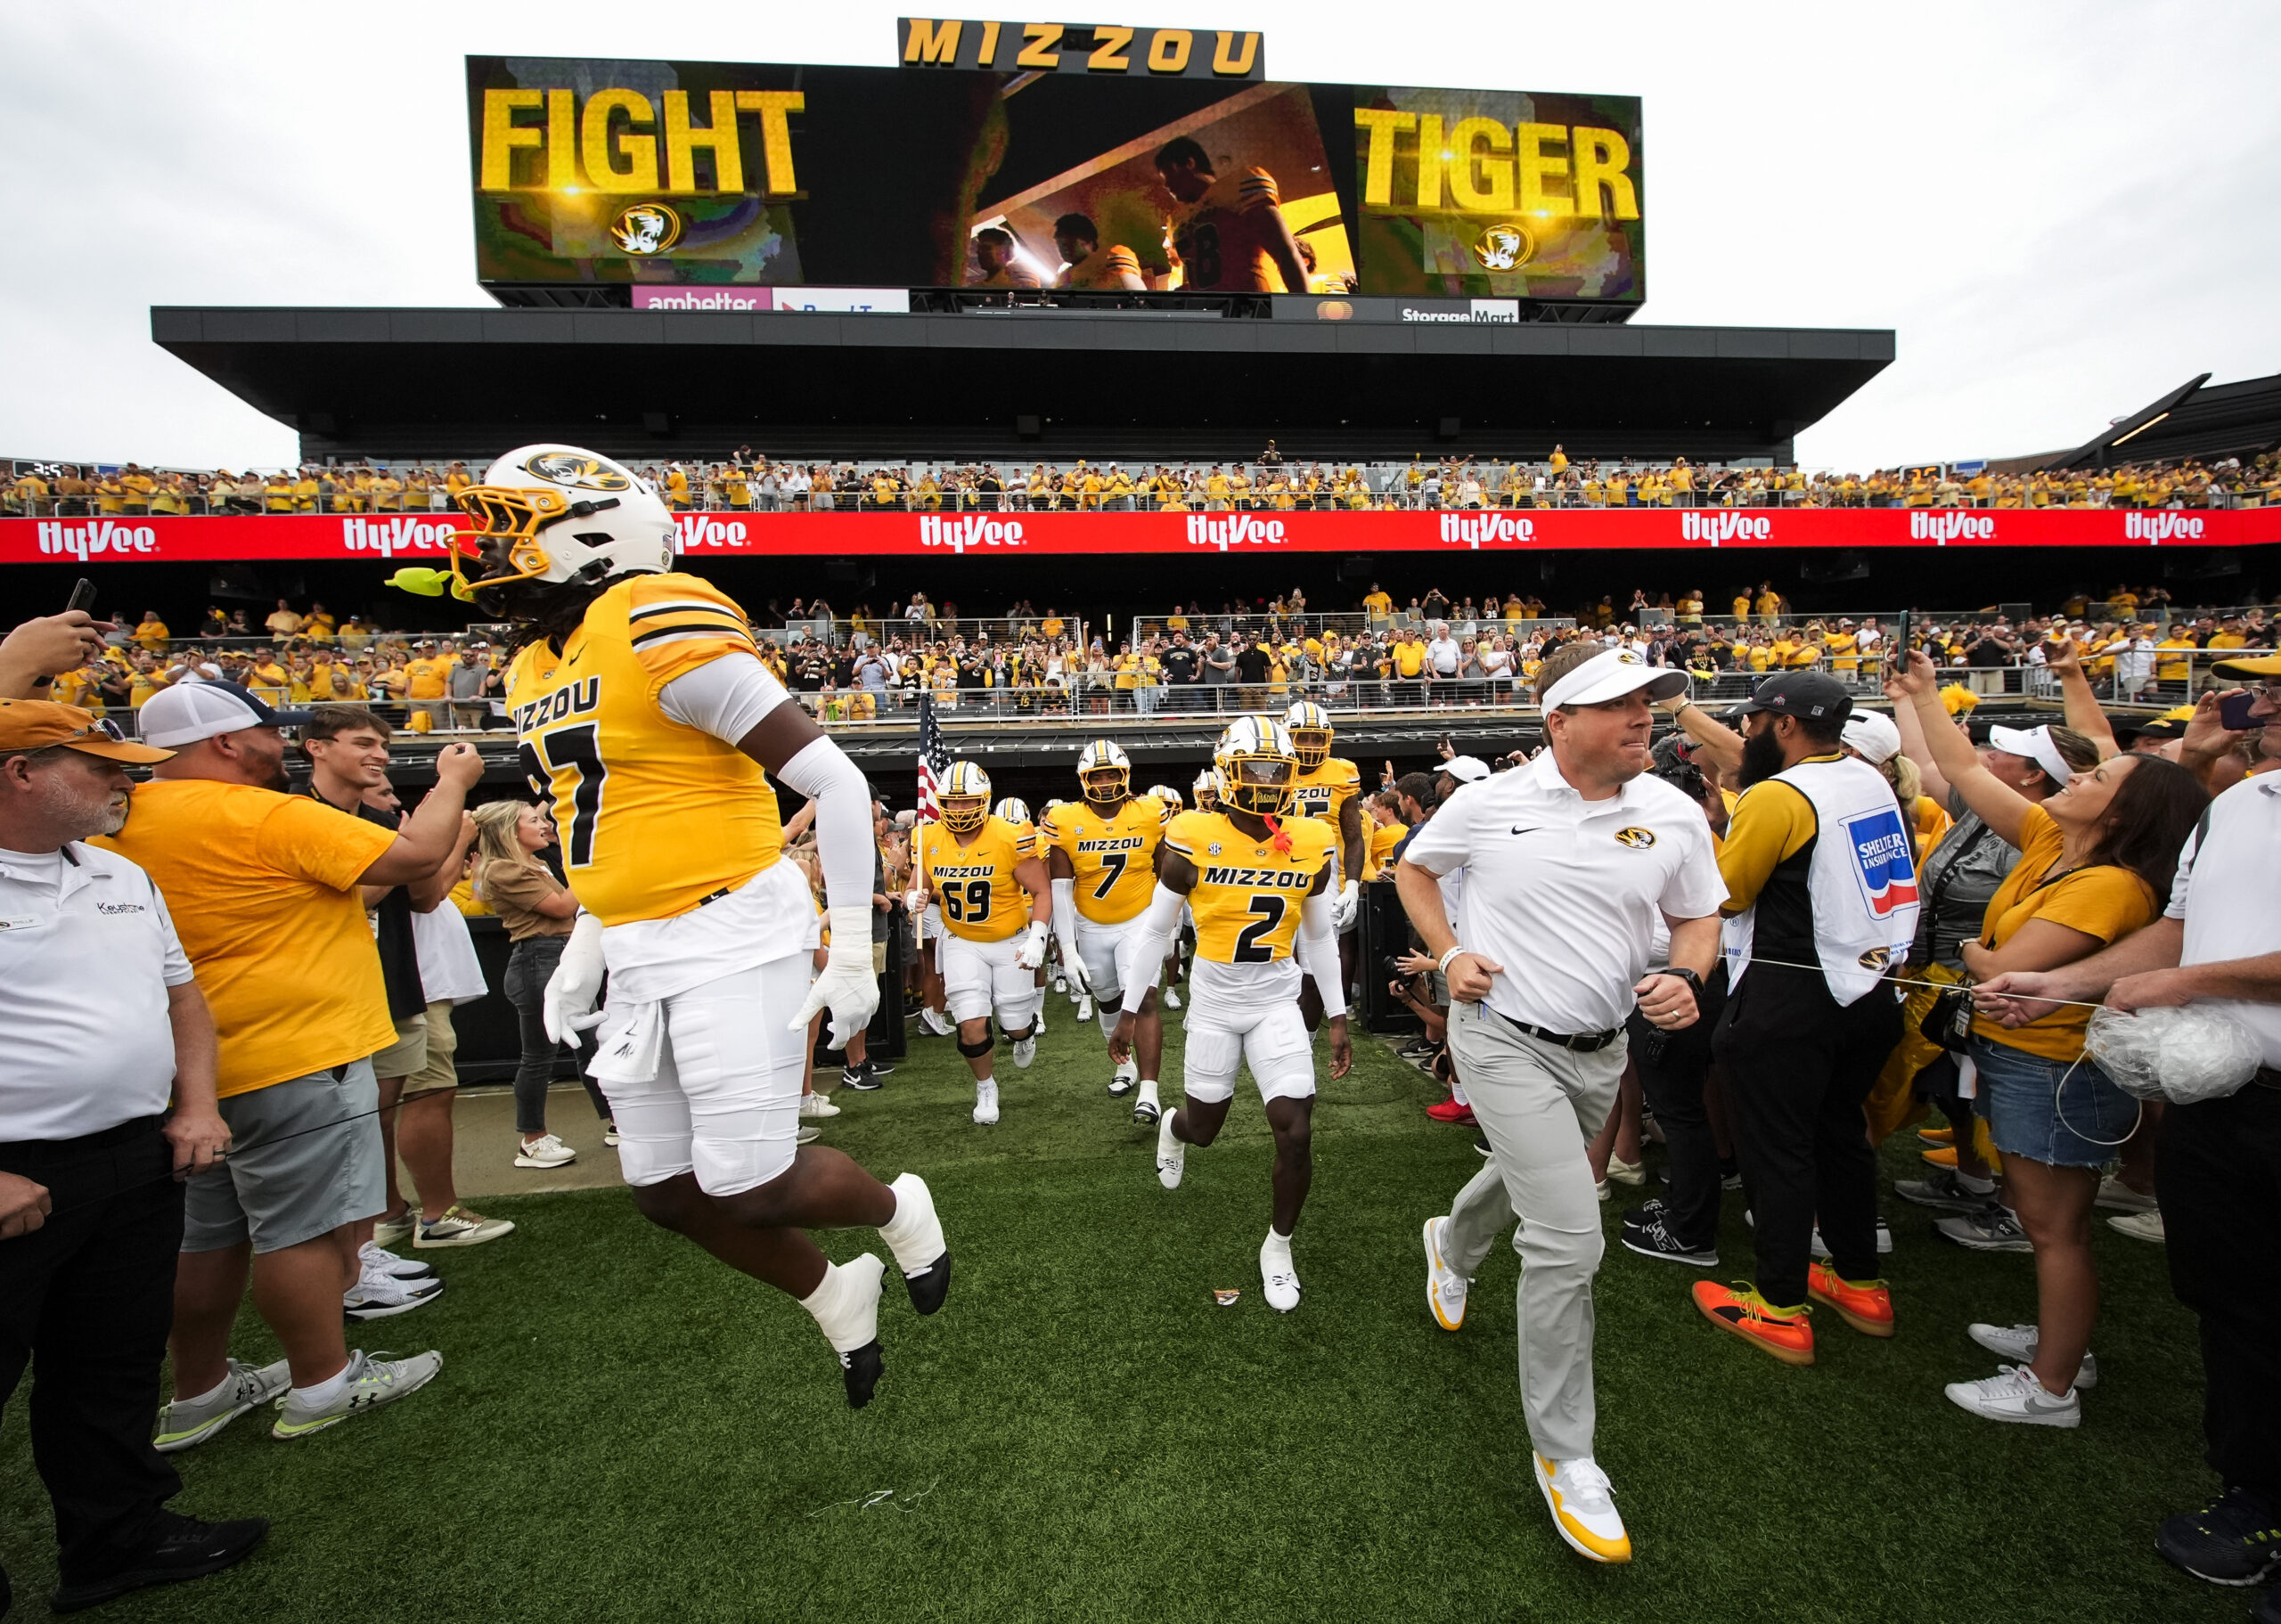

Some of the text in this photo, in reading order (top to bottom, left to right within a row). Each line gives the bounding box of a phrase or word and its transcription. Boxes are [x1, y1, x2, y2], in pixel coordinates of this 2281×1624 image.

[904, 19, 1259, 74] MIZZOU
[481, 88, 805, 193] FIGHT
[1353, 108, 1639, 221] TIGER
[37, 521, 155, 561] HyVee
[343, 518, 456, 558] HyVee
[920, 515, 1023, 553] HyVee
[1187, 514, 1284, 551] HyVee
[1440, 513, 1533, 550] HyVee
[1681, 511, 1770, 547] HyVee
[1910, 511, 1994, 546] HyVee
[2125, 512, 2203, 546] HyVee
[513, 674, 601, 736] IZZOU
[1077, 836, 1144, 853] MIZZOU
[1208, 842, 1222, 856] SEC
[1858, 833, 1905, 859] SHELTER
[933, 865, 994, 878] MIZZOU
[1092, 853, 1128, 900] 7
[1203, 866, 1312, 889] MIZZOU
[941, 880, 992, 924] 69
[1232, 894, 1287, 965] 2
